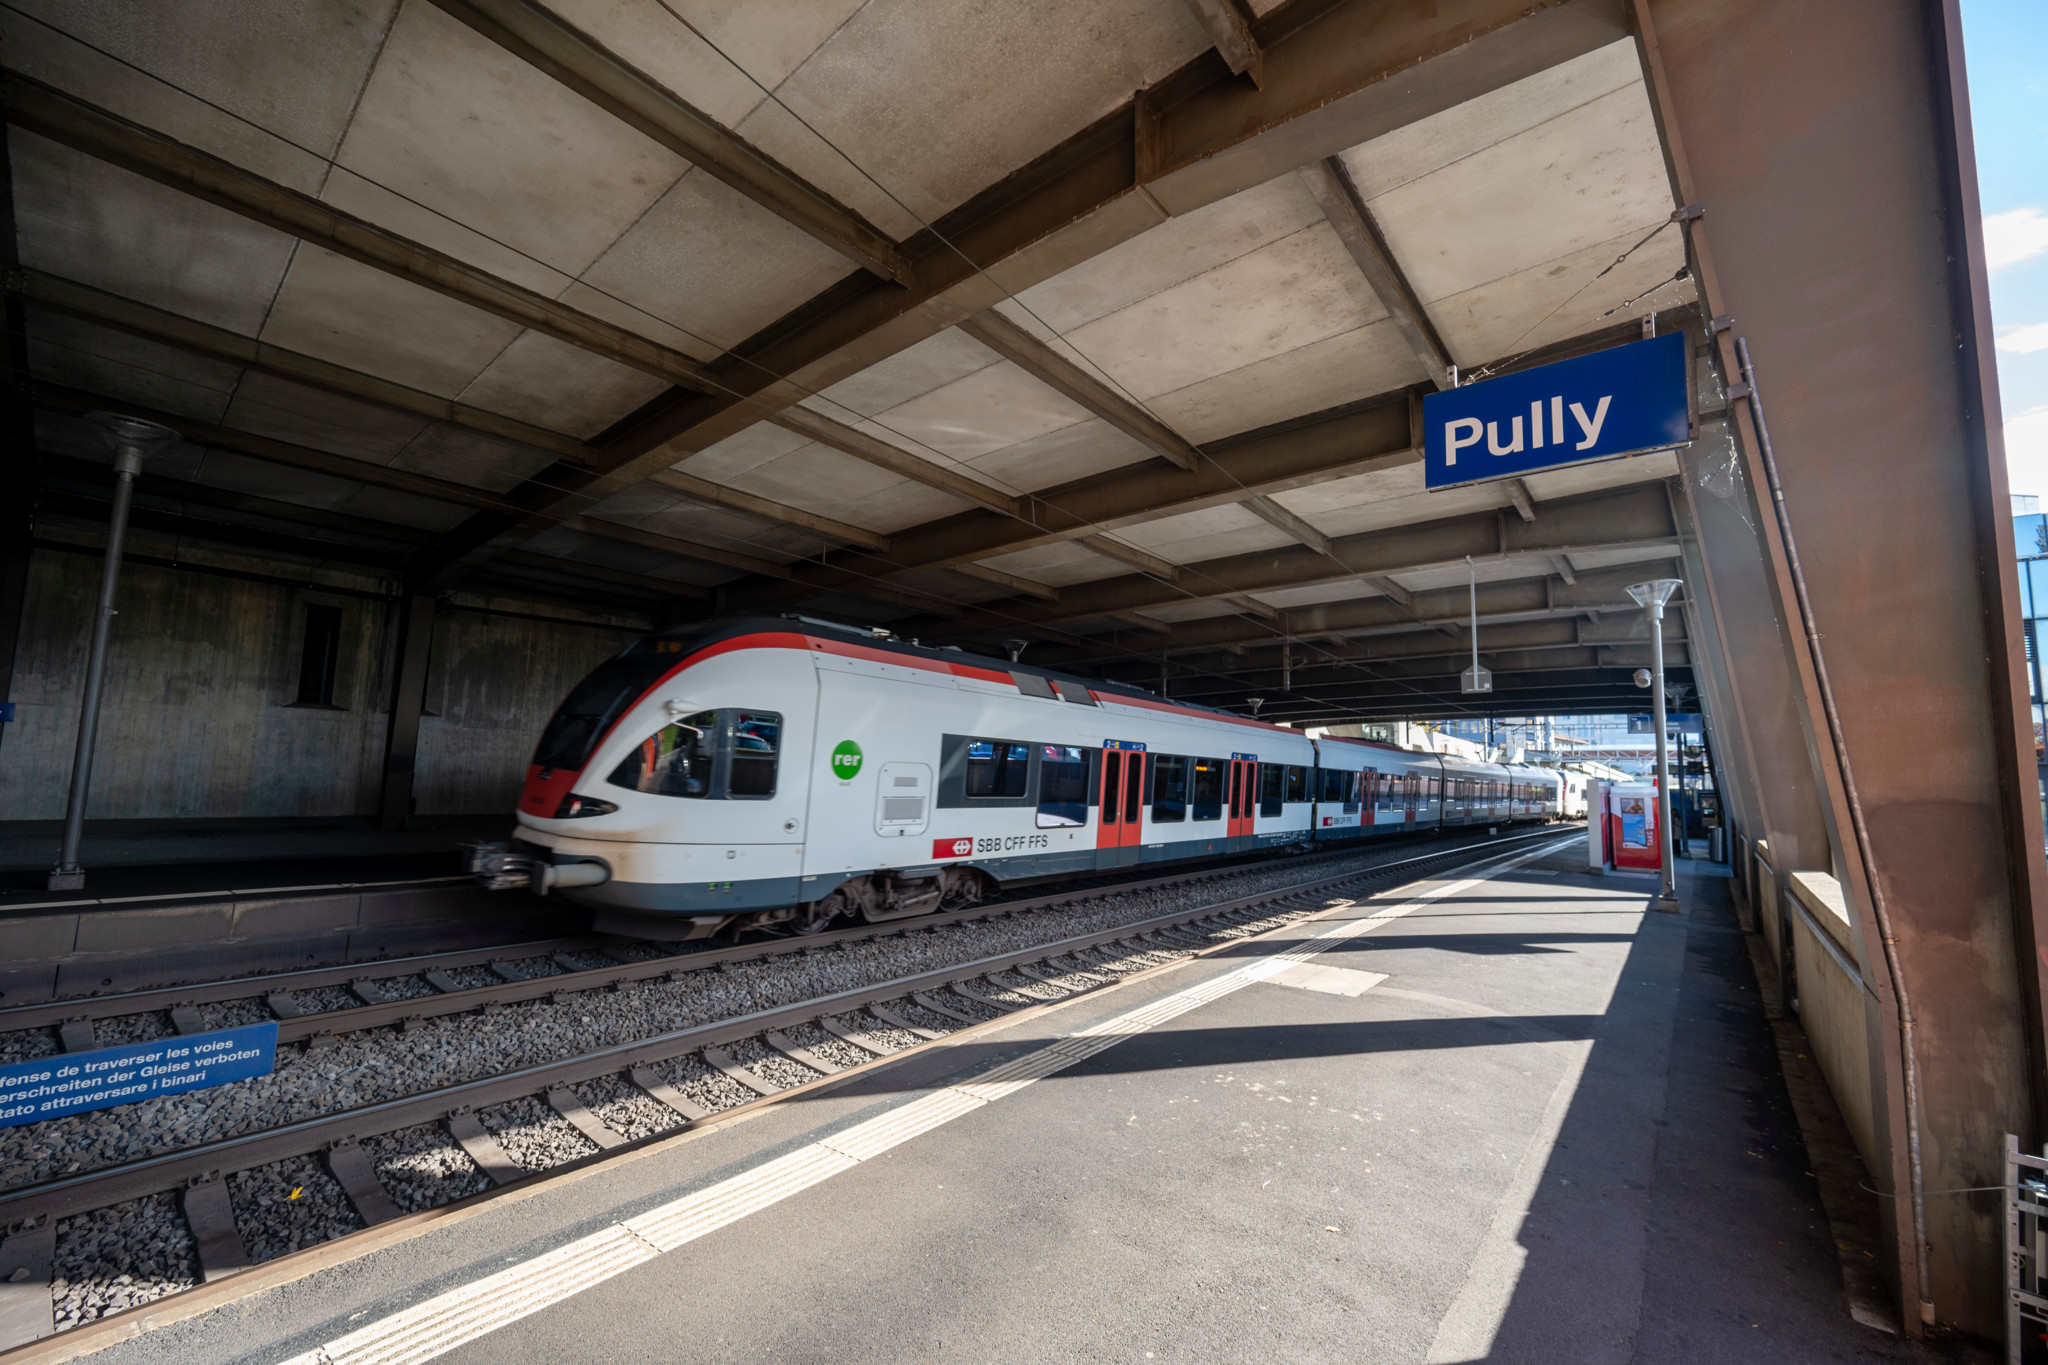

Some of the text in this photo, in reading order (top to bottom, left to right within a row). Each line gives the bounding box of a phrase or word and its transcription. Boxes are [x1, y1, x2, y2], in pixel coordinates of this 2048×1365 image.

[1445, 395, 1612, 466] Pully
[1635, 720, 1642, 731] 1
[834, 754, 861, 766] rer
[977, 834, 1048, 853] SBB CFF FFS
[56, 1065, 79, 1078] de
[84, 1052, 163, 1073] traverser
[166, 1047, 190, 1059] les
[194, 1040, 234, 1054] voies
[107, 1071, 137, 1084] der
[140, 1061, 190, 1077] Gleise
[195, 1048, 260, 1068] verboten
[40, 1083, 148, 1112] attraversare
[152, 1079, 157, 1090] i
[161, 1070, 206, 1089] binari
